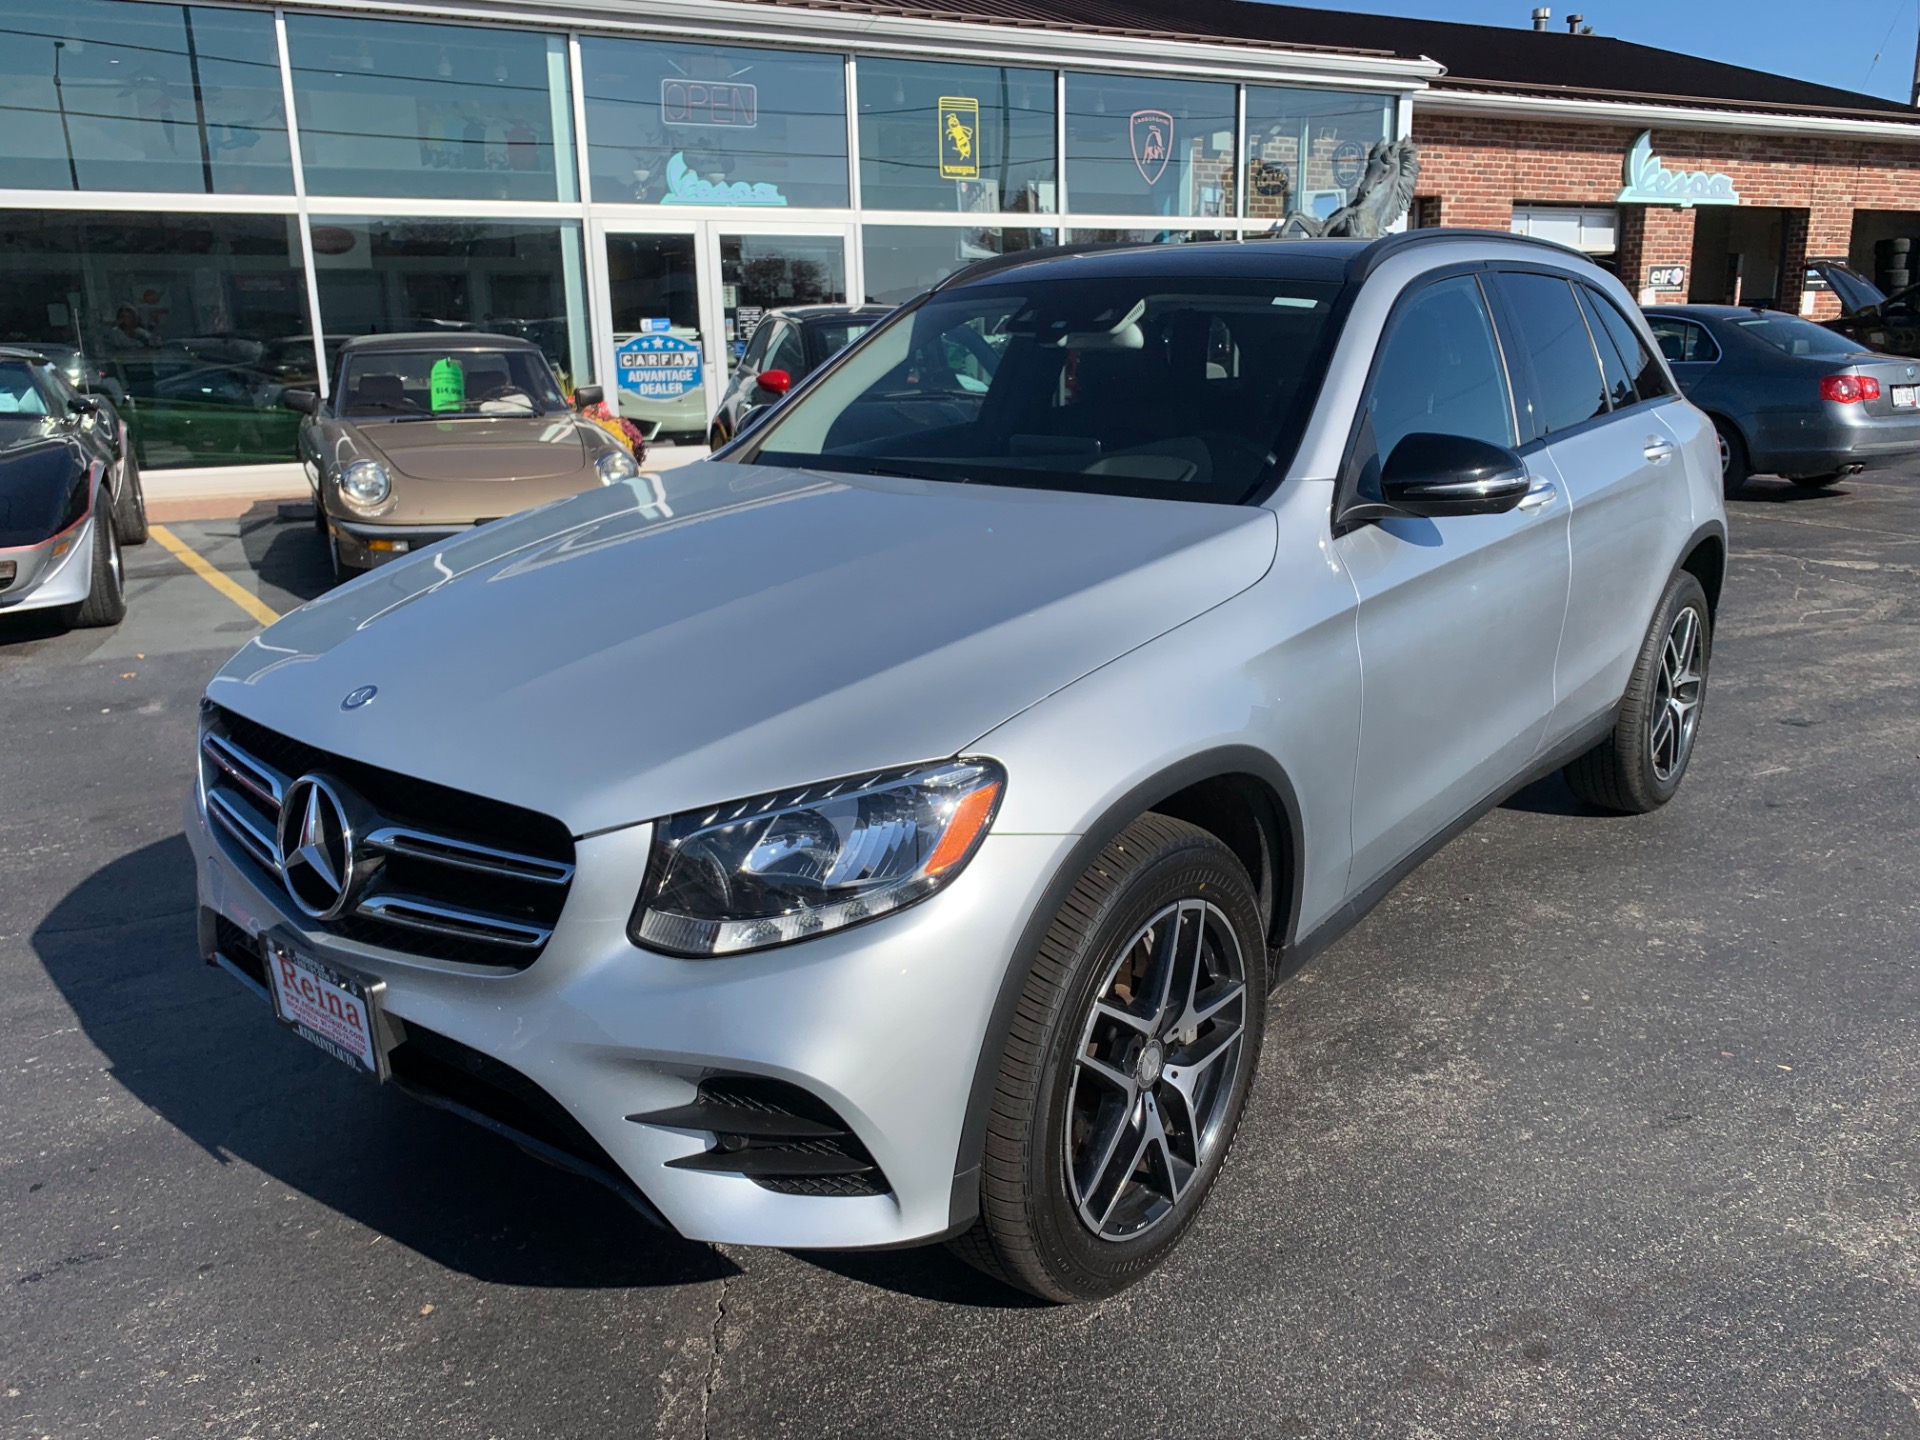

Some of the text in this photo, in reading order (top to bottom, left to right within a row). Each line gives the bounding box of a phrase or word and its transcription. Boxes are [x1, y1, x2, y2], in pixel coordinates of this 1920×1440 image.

[665, 83, 754, 124] OPEN
[664, 151, 784, 203] Vespa
[1625, 128, 1738, 202] Vespa
[1650, 269, 1671, 284] elf
[628, 369, 694, 382] ADVANTAGE
[640, 382, 683, 395] DEALER
[278, 956, 363, 1032] Reina
